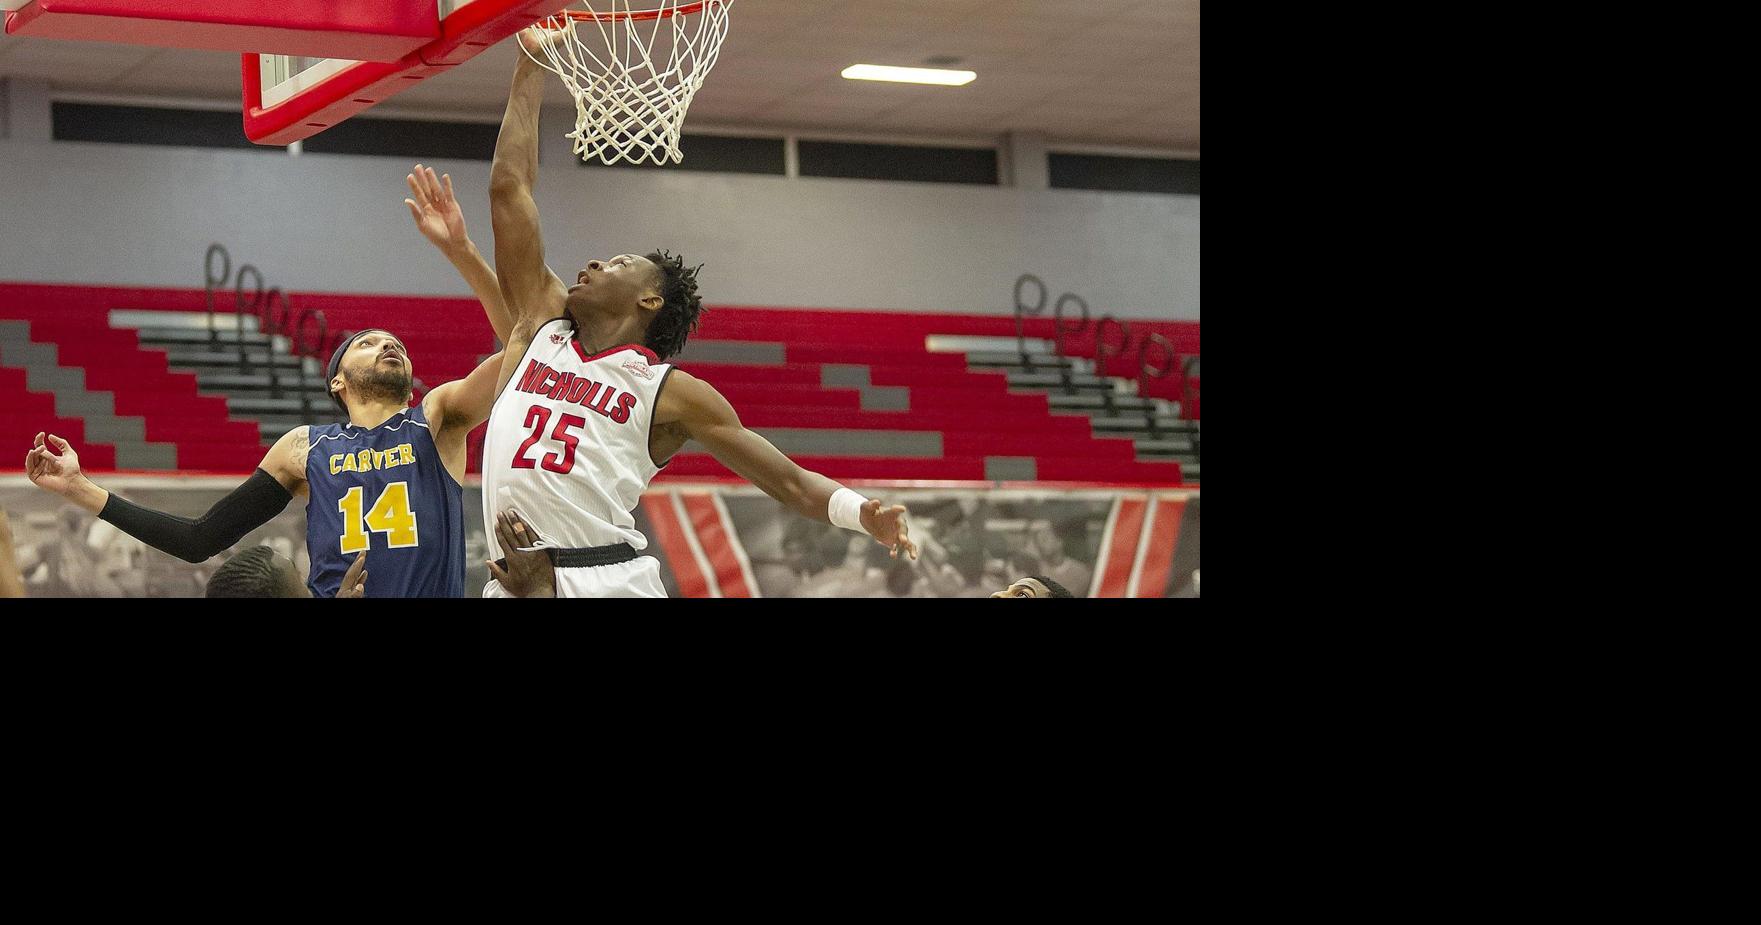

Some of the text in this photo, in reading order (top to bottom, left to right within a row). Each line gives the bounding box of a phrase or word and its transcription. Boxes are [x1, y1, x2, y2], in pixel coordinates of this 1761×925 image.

[329, 443, 416, 475] CARVER
[511, 404, 586, 474] 25
[338, 481, 419, 555] 14
